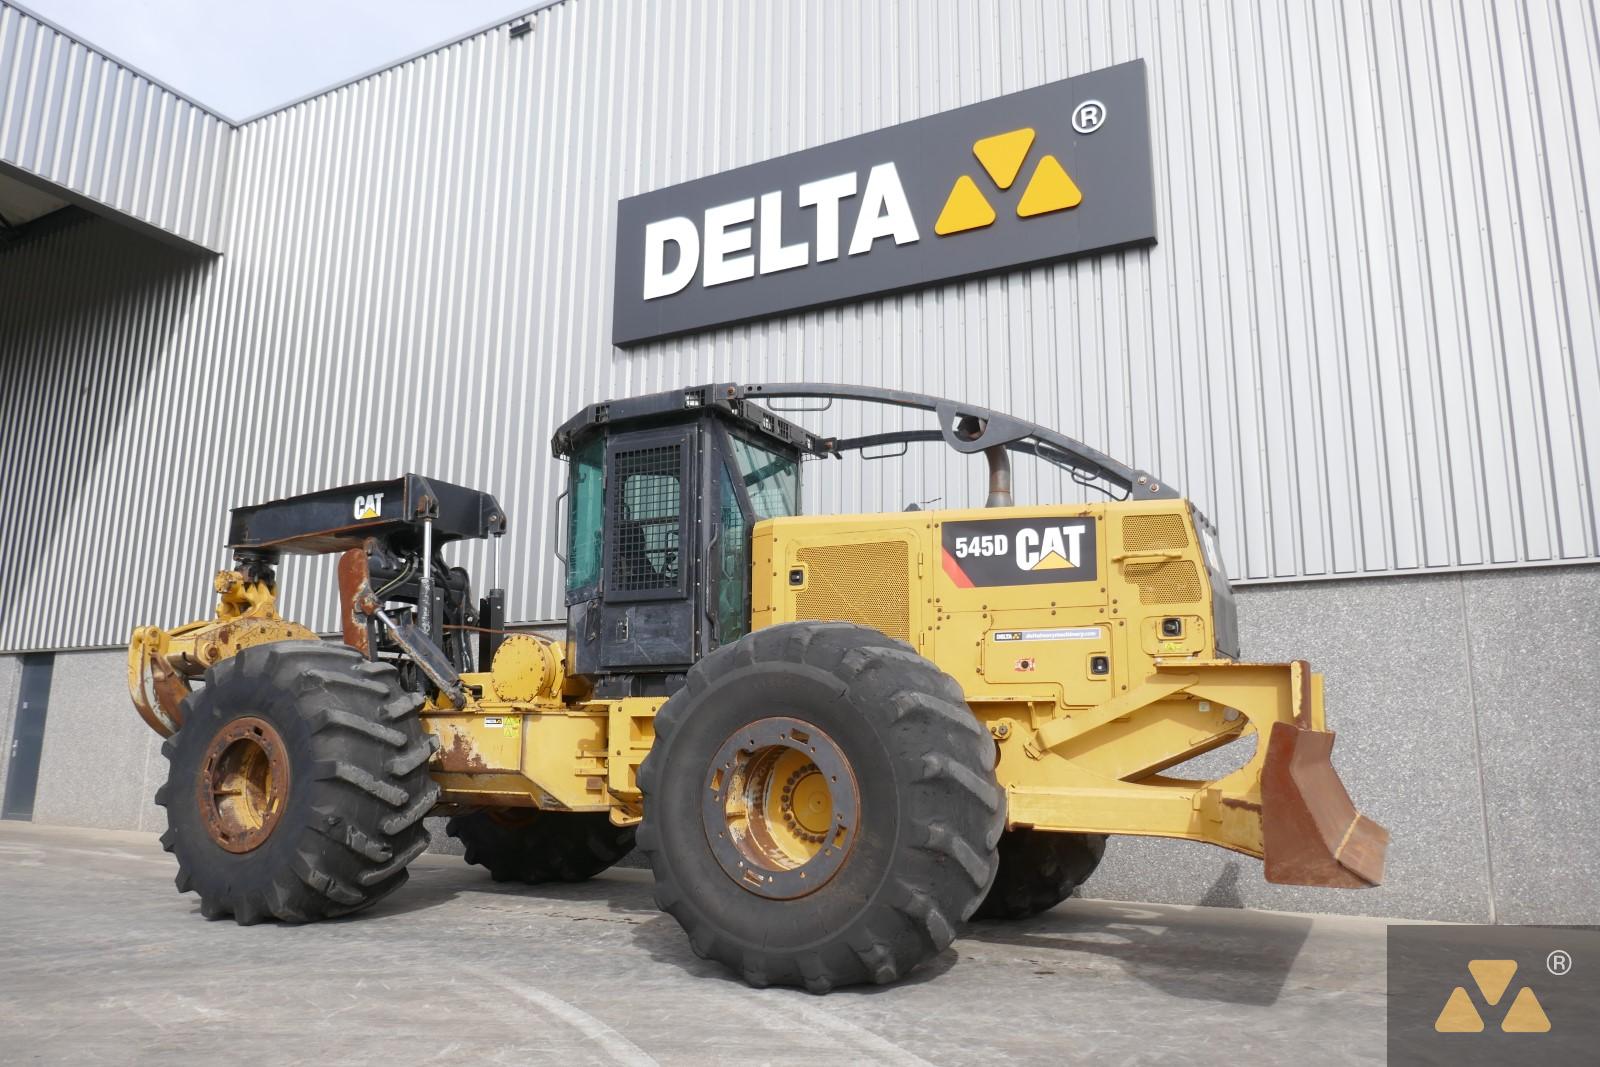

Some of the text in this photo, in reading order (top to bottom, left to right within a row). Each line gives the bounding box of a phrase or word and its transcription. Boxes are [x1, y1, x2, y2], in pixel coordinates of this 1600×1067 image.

[643, 161, 920, 301] DELTA
[354, 492, 385, 520] CAT
[955, 525, 1086, 570] 545D CAT
